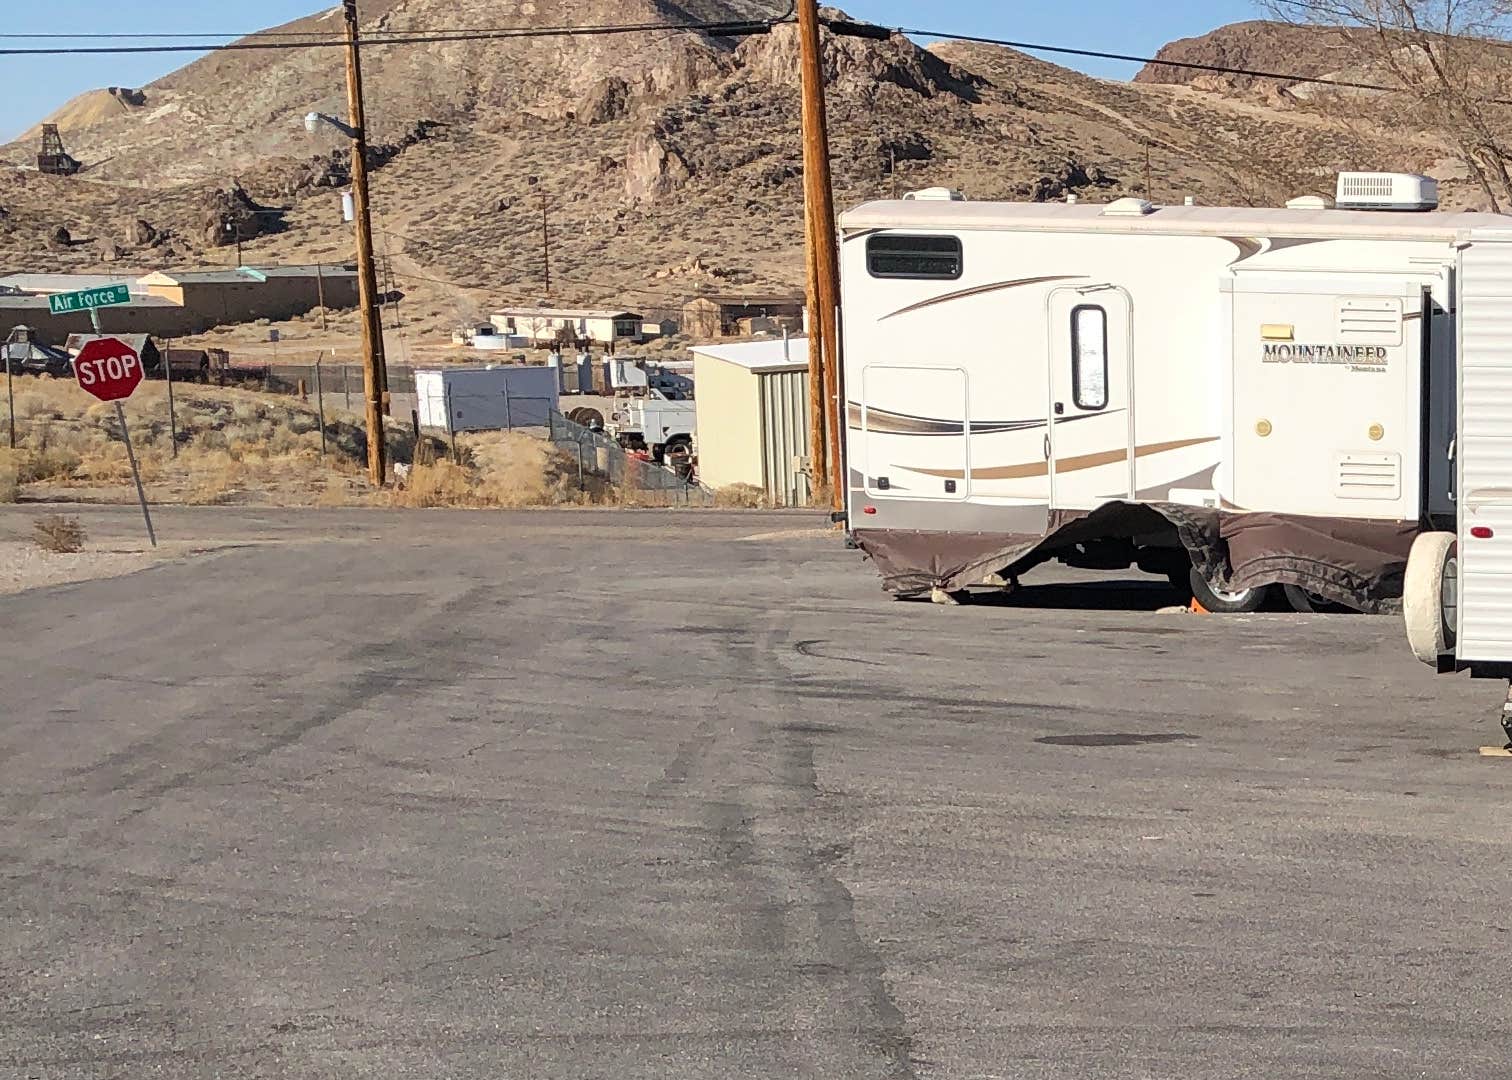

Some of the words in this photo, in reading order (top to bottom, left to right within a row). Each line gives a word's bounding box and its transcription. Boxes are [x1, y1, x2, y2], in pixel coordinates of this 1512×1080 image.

[54, 295, 73, 311] Air
[78, 291, 115, 307] Force
[1262, 343, 1388, 365] MOUNTAINEER
[79, 354, 136, 385] STOP
